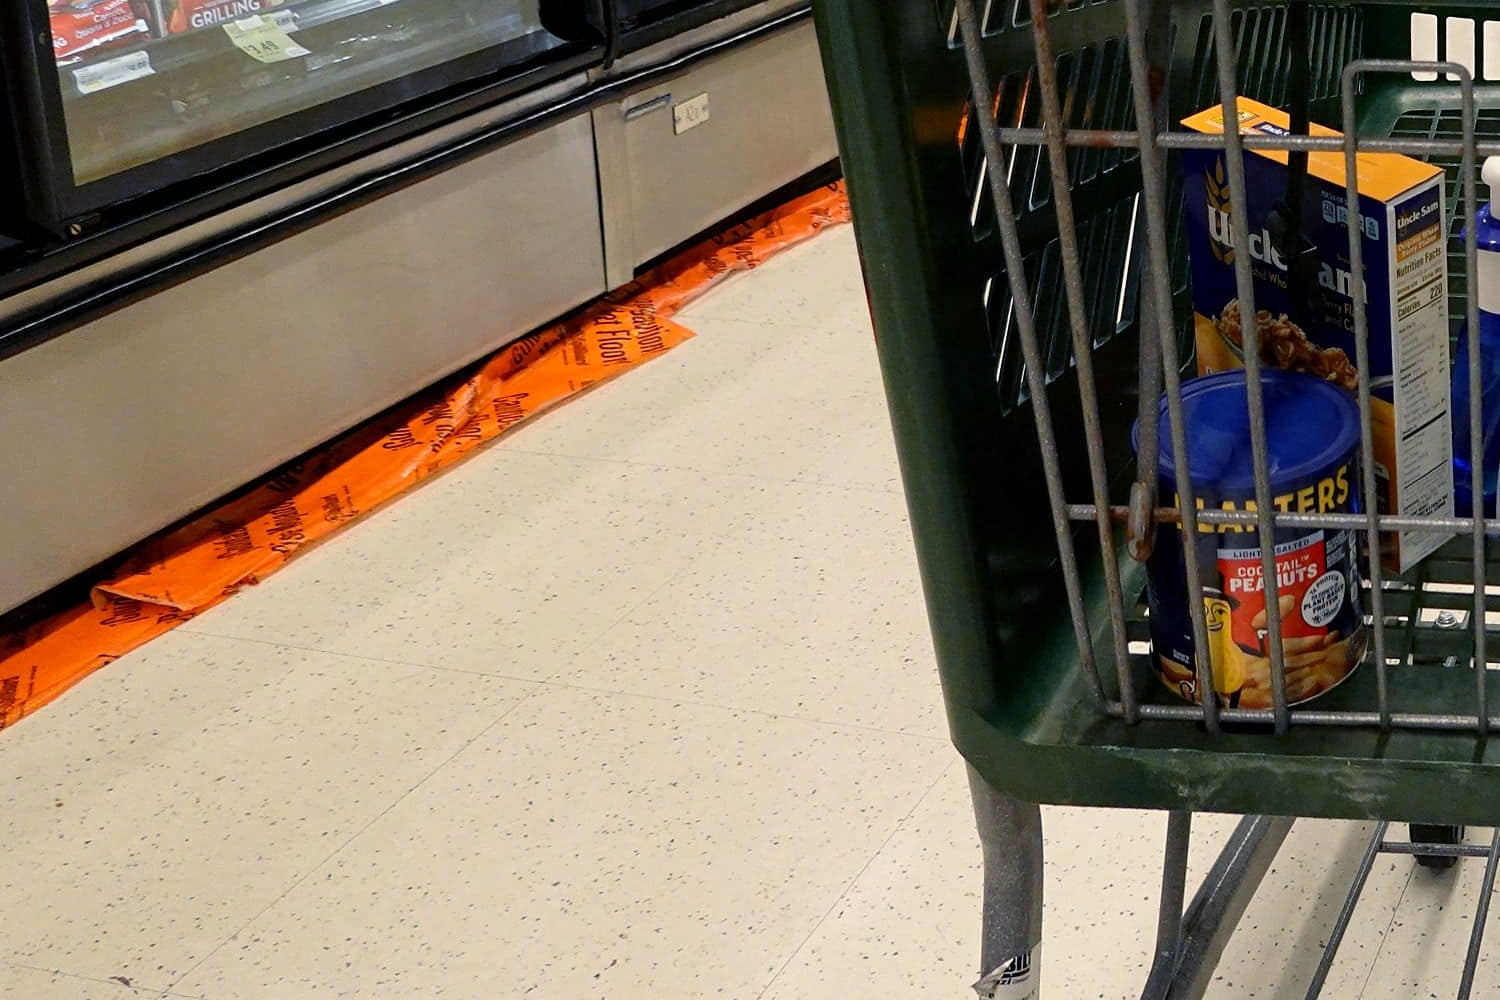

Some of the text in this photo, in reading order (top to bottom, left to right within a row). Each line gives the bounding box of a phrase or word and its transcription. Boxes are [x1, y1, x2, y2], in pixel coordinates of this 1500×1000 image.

[1397, 202, 1439, 230] Uncle Sam
[1397, 247, 1441, 281] Nutrition Facts
[1268, 272, 1288, 289] Who
[1317, 260, 1368, 305] am
[1429, 283, 1443, 300] 220
[1397, 301, 1421, 319] Calories
[1233, 549, 1264, 559] LIGHT
